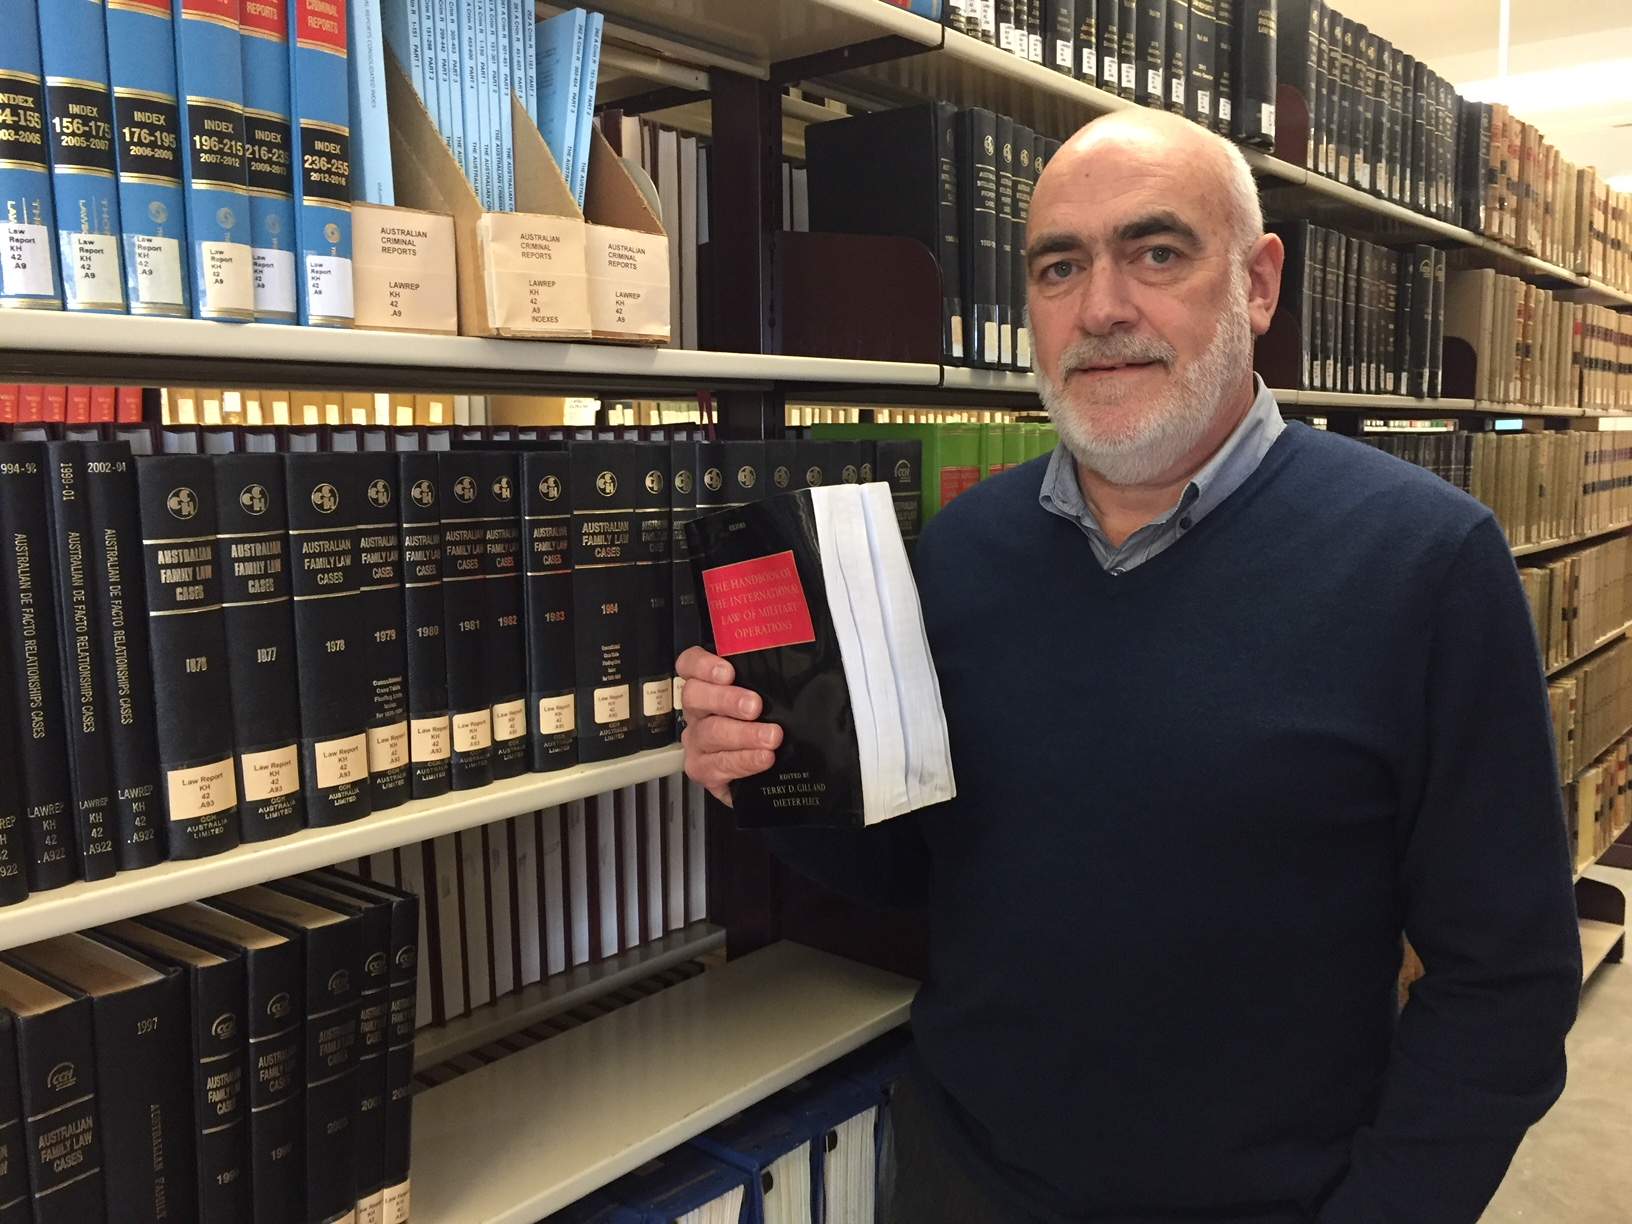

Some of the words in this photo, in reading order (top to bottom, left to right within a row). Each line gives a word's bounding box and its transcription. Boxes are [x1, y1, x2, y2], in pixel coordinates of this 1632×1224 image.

[0, 93, 34, 108] NDEX
[69, 104, 99, 117] INDEX
[134, 111, 166, 126] INDEX
[52, 117, 111, 139] 156-175
[204, 119, 234, 133] INDEX
[123, 127, 176, 149] 176-195
[255, 130, 282, 143] INDEX
[193, 135, 243, 156] 196-215
[314, 141, 341, 154] INDEX
[304, 155, 350, 176] 236-255
[381, 227, 428, 238] AUSTRALIAN
[520, 233, 560, 243] AUSTRALIAN
[9, 236, 36, 245] Report
[381, 236, 416, 247] CRIMINAL
[521, 242, 551, 251] CRIMINAL
[79, 246, 104, 255] Report
[137, 244, 162, 252] Report
[382, 246, 417, 256] REPORTS
[608, 243, 646, 255] AUSTRALIAN
[522, 251, 552, 261] REPORTS
[608, 251, 637, 261] CRIMINAL
[608, 260, 638, 270] REPORTS
[389, 281, 420, 290] LAWREP
[529, 280, 556, 288] LAWREP
[390, 290, 401, 298] KH
[615, 291, 641, 299] LAWREP
[582, 522, 629, 533] AUSTRALIAN
[582, 533, 611, 546] FAMILY
[231, 541, 281, 558] AUSTRALIAN
[303, 539, 351, 553] AUSTRALIAN
[447, 544, 472, 556] FAMILY
[534, 541, 555, 552] FAMILY
[595, 546, 621, 558] CASES
[14, 533, 32, 589] AUSTRALIAN
[68, 532, 84, 586] AUSTRALIAN
[104, 529, 121, 581] AUSTRALIAN
[361, 552, 387, 564] FAMILY
[406, 550, 430, 561] FAMILY
[543, 554, 562, 566] CASES
[304, 557, 336, 570] FAMILY
[336, 555, 351, 567] LAW
[457, 559, 479, 570] CASES
[496, 556, 514, 568] CASES
[234, 561, 265, 576] FAMILY
[372, 567, 393, 579] CASES
[416, 564, 436, 576] CASES
[317, 571, 343, 585] CASES
[109, 585, 122, 597] DE
[248, 578, 274, 593] CASES
[20, 593, 33, 605] DE
[73, 589, 86, 602] DE
[176, 585, 204, 601] CASES
[73, 604, 88, 632] FACTO
[110, 600, 124, 627] FACTO
[721, 613, 741, 626] LAW
[743, 609, 757, 621] OF
[21, 608, 36, 636] FACTO
[459, 619, 480, 631] 1981
[498, 615, 518, 627] 1982
[374, 630, 396, 642] 1979
[734, 623, 793, 639] OPERATIONS
[76, 635, 93, 703] RELATIONSHIPS
[113, 630, 130, 696] RELATIONSHIPS
[24, 639, 42, 708] RELATIONSHIPS
[119, 698, 133, 724] CASES
[31, 710, 45, 739] CASES
[81, 705, 95, 733] CASES
[200, 773, 223, 783] Report
[118, 786, 153, 800] LAWREP
[762, 785, 786, 795] TERRY
[80, 798, 108, 810] LAWREP
[132, 802, 145, 813] KH
[773, 798, 801, 807] DIETER
[27, 803, 64, 818] LAWREP
[89, 813, 103, 823] KH
[135, 816, 147, 826] 42
[43, 820, 56, 830] KH
[187, 819, 227, 832] AUSTRALIA
[91, 828, 103, 838] 42
[194, 828, 224, 839] LIMITED
[45, 835, 57, 846] 42
[136, 1017, 158, 1035] 1997
[39, 1116, 93, 1150] AUSTRALIAN
[41, 1140, 71, 1163] FAMILY
[73, 1130, 92, 1149] LAW
[53, 1150, 84, 1173] CASES
